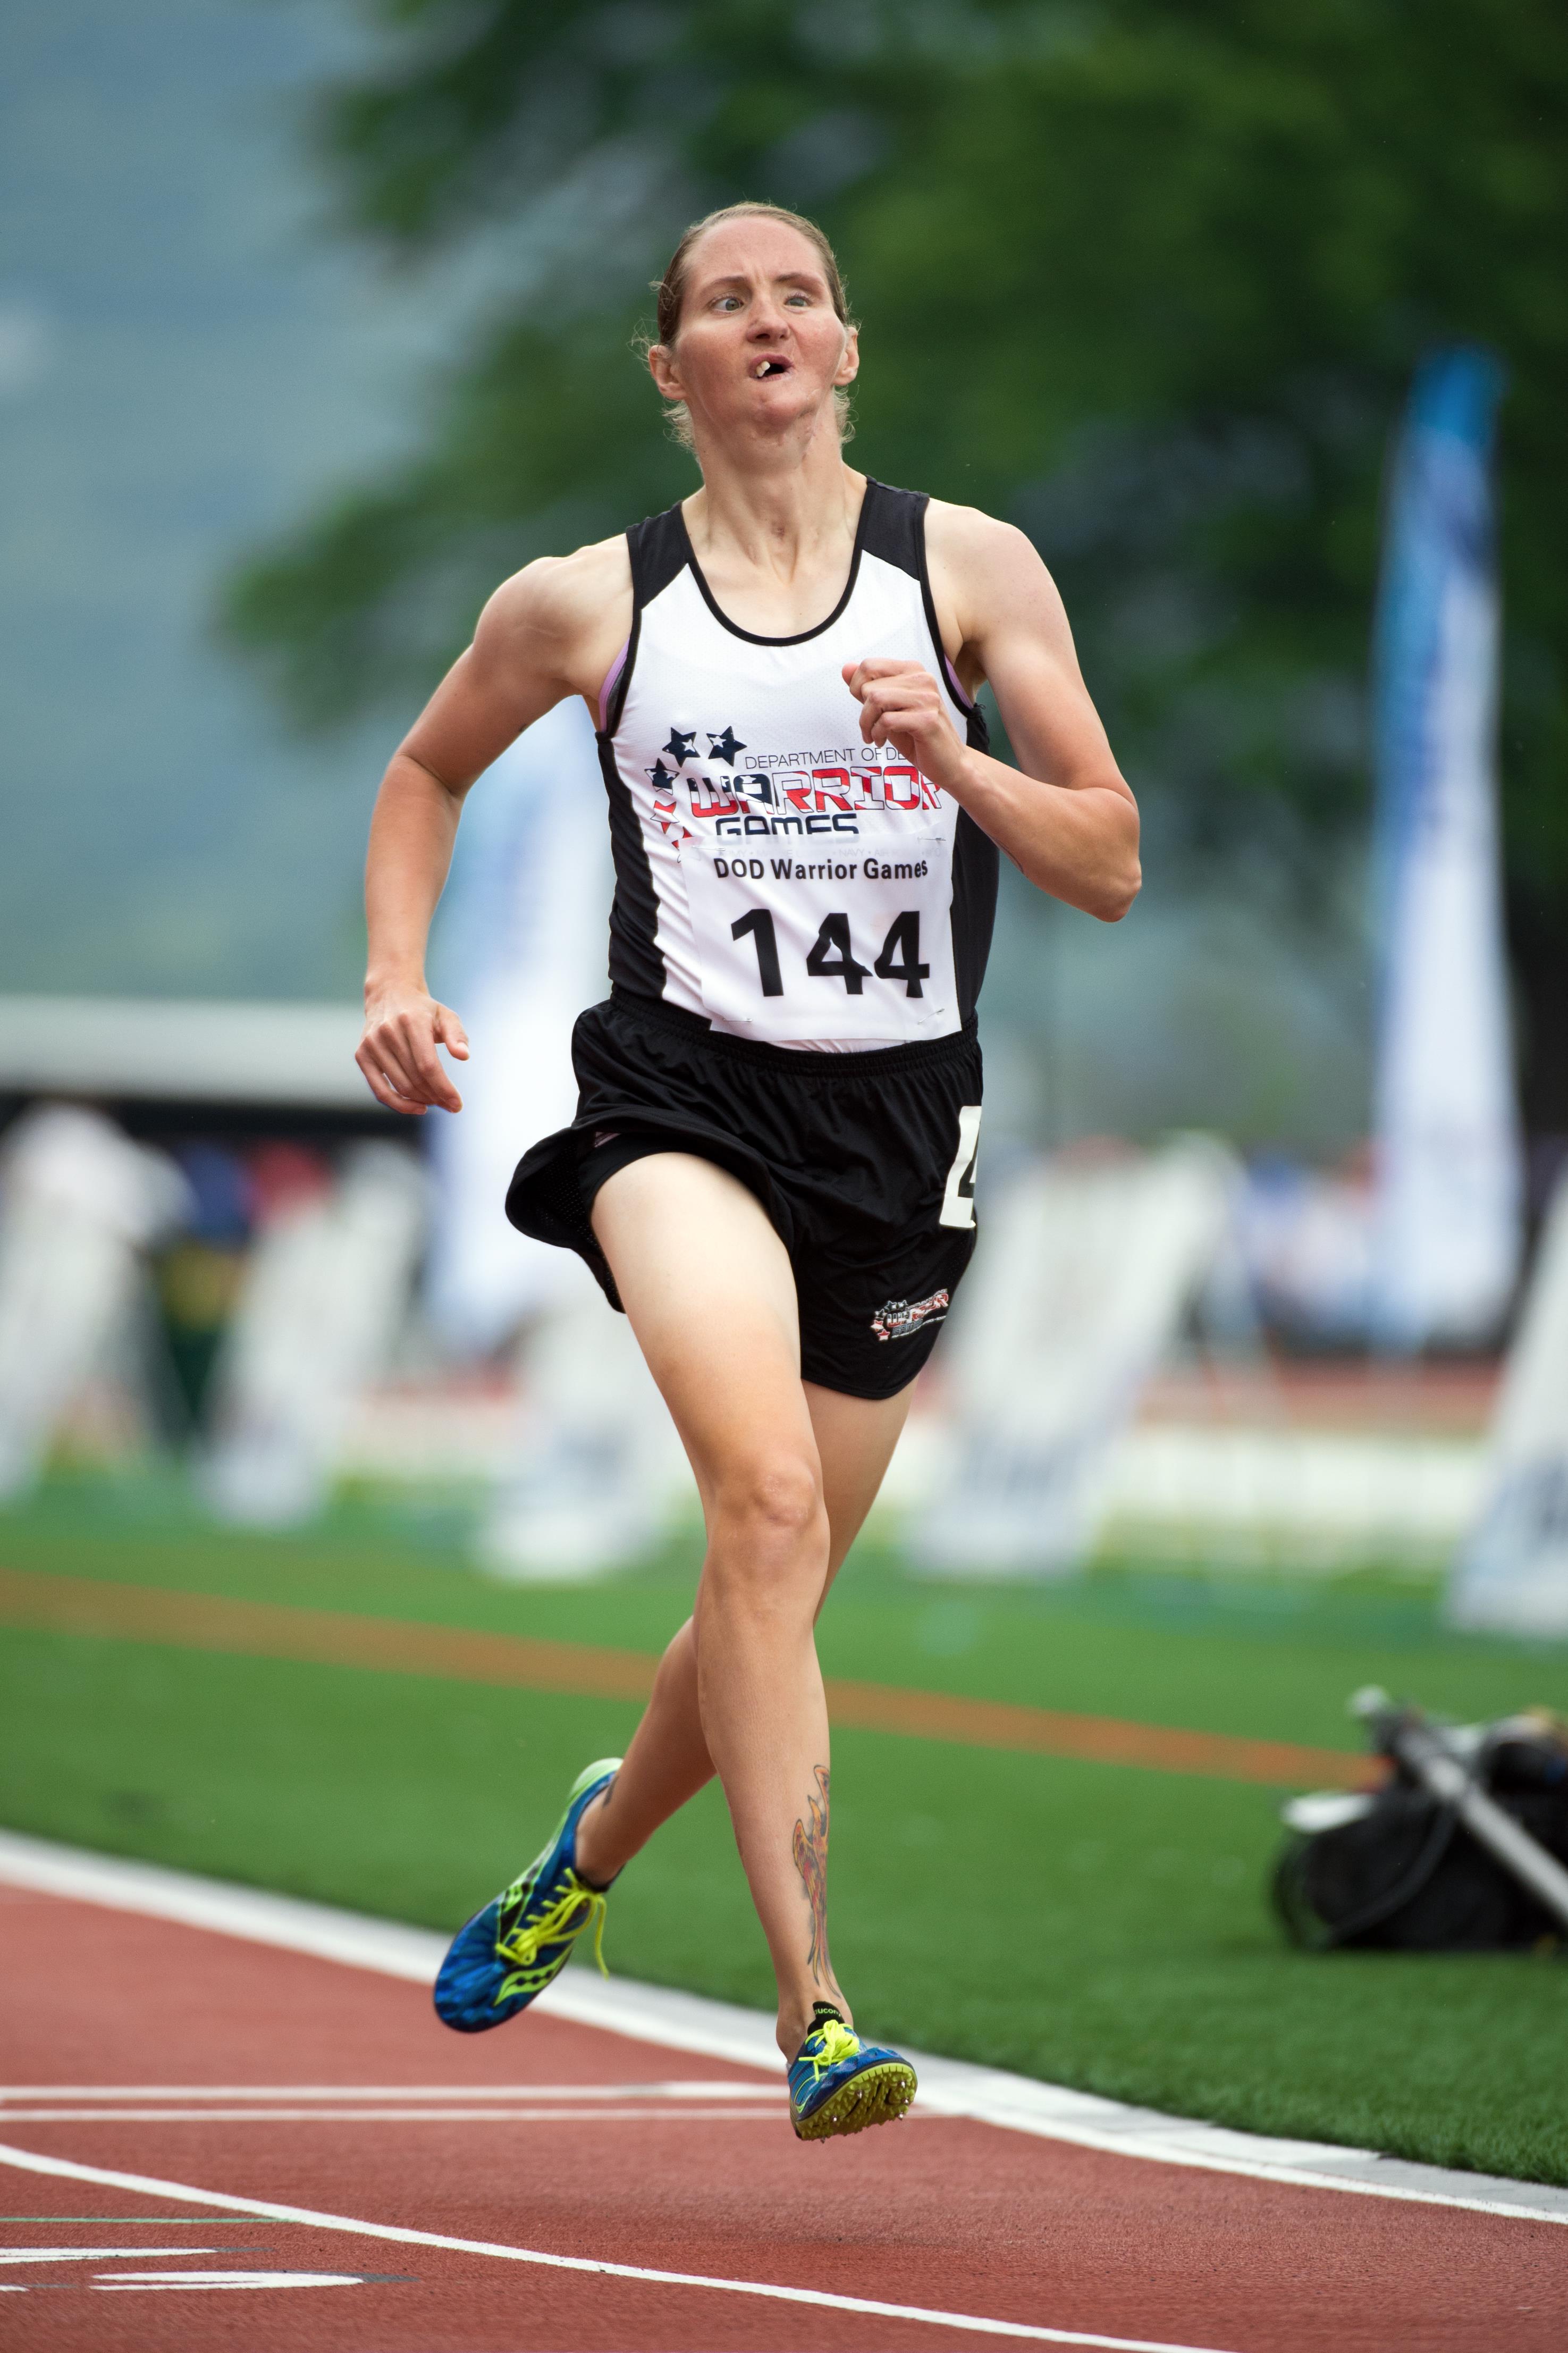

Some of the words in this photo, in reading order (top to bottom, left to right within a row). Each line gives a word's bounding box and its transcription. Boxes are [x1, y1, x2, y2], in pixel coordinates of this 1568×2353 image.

[745, 748, 855, 769] DEPARTMENT
[861, 747, 882, 761] OF
[686, 766, 942, 818] WARRIOR
[714, 858, 764, 879] DOD
[771, 858, 857, 880] Warrior
[864, 858, 928, 879] Games
[731, 909, 930, 998] 144
